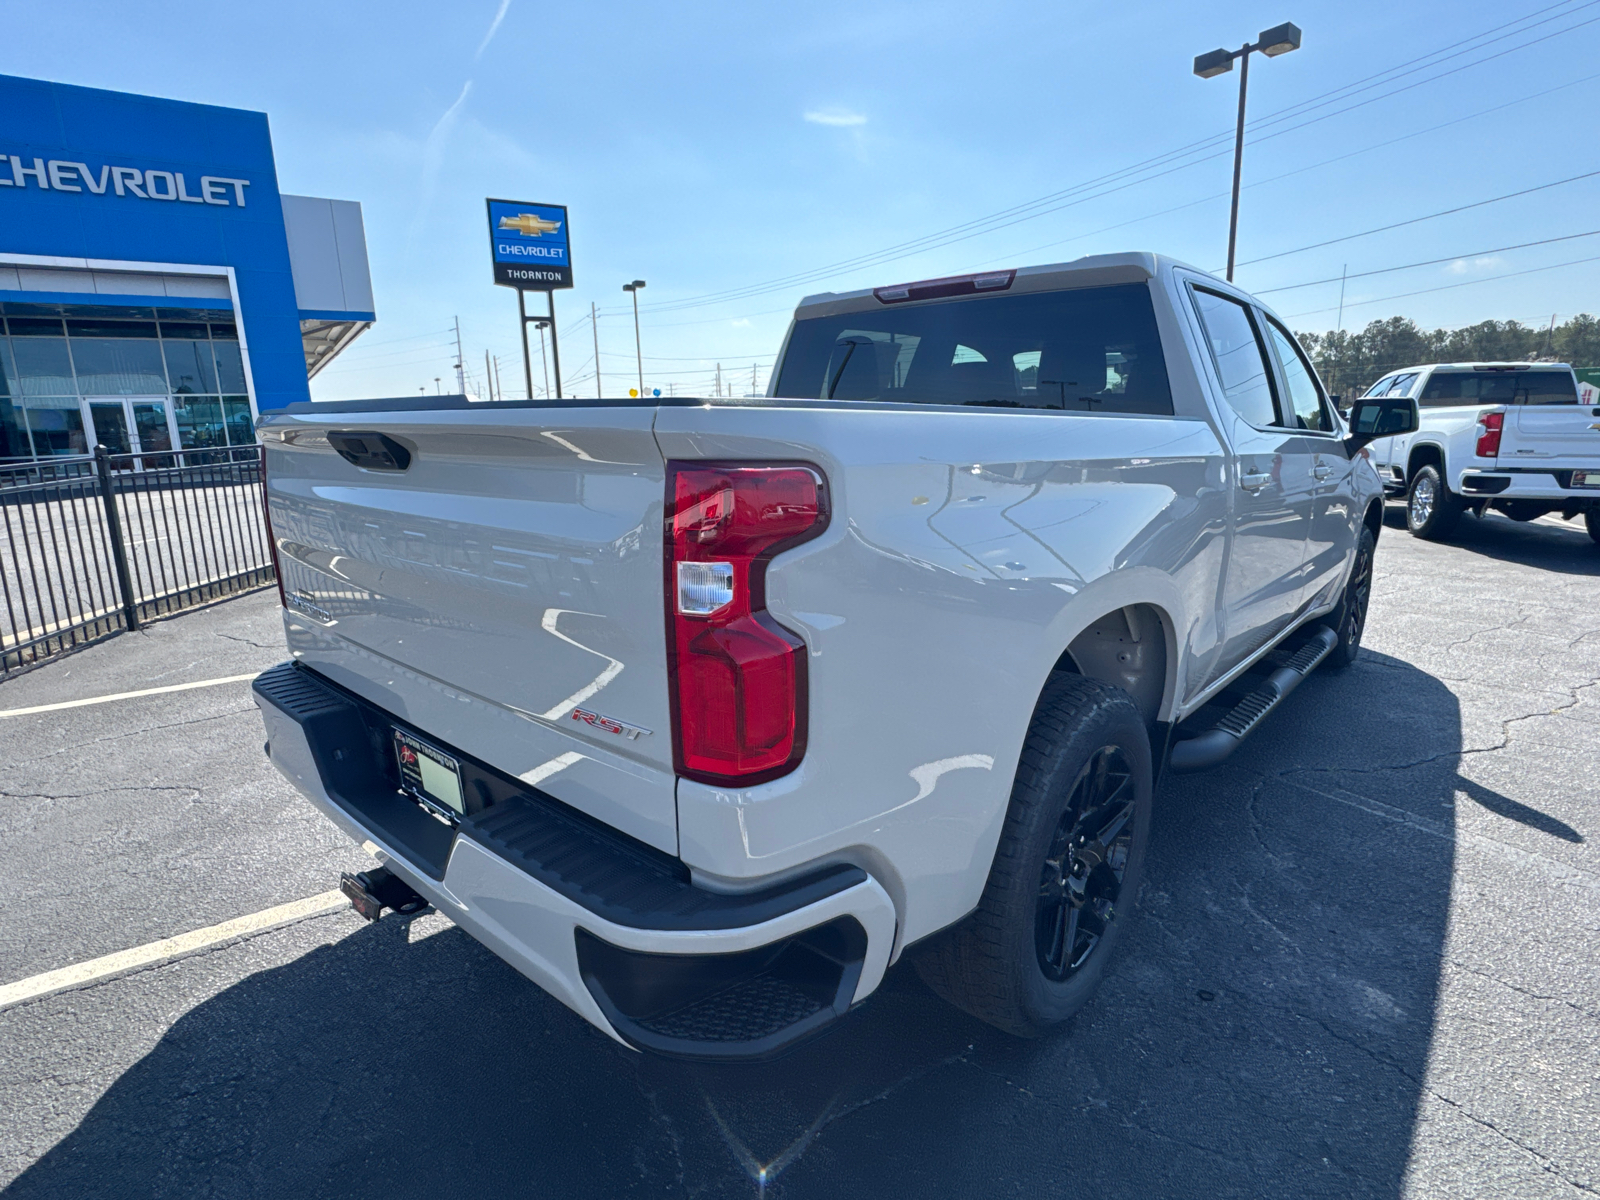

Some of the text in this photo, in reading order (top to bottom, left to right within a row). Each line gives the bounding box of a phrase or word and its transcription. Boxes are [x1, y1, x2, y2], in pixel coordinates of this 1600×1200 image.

[0, 154, 250, 207] HEVROLET
[499, 245, 563, 258] CHEVROLET
[507, 269, 561, 280] THORNTON
[571, 706, 654, 740] RST
